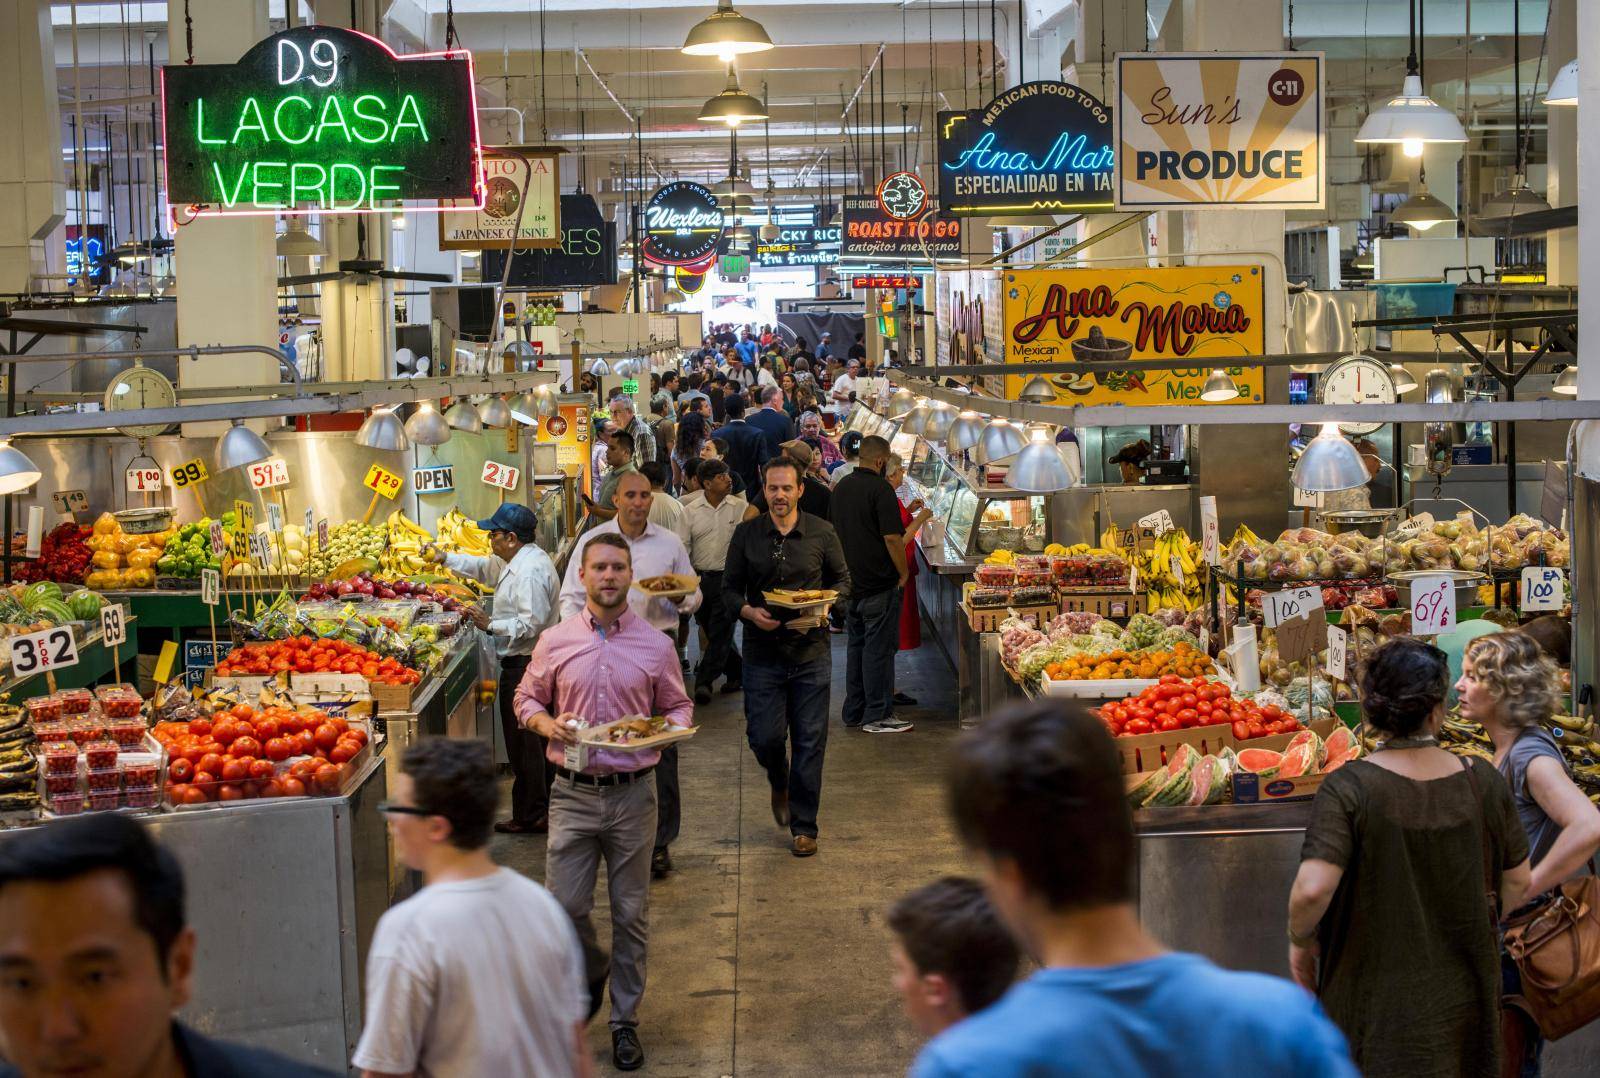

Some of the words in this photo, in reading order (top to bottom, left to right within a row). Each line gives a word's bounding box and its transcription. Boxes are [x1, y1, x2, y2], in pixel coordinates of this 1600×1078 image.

[278, 39, 339, 87] D9
[982, 85, 1039, 127] MEXICAN
[1042, 84, 1076, 99] FOOD
[1078, 92, 1094, 108] TO
[1092, 106, 1108, 124] GO
[1141, 86, 1242, 125] Sun's
[945, 132, 1029, 170] Ana
[1031, 132, 1114, 170] Mar
[1136, 150, 1303, 180] PRODUCE
[213, 161, 407, 211] VERDE
[653, 184, 678, 205] HOUSE
[688, 184, 716, 206] SMOKED
[955, 173, 1057, 195] ESPECIALIDAD
[1065, 173, 1084, 191] EN
[453, 228, 506, 240] JAPANESE
[848, 221, 904, 238] ROAST
[908, 221, 931, 238] TO
[934, 221, 960, 237] GO
[848, 241, 896, 256] antojitos
[723, 256, 745, 273] EXIT
[857, 278, 919, 287] PIZZA
[1013, 283, 1120, 344] Ana
[1121, 300, 1250, 356] Maria
[1012, 344, 1060, 356] Mexican
[415, 468, 453, 491] OPEN
[1543, 571, 1561, 581] EA
[1298, 590, 1313, 600] EA
[104, 609, 120, 643] 69
[13, 639, 38, 672] 3
[38, 639, 50, 666] FOR
[50, 630, 75, 665] 2
